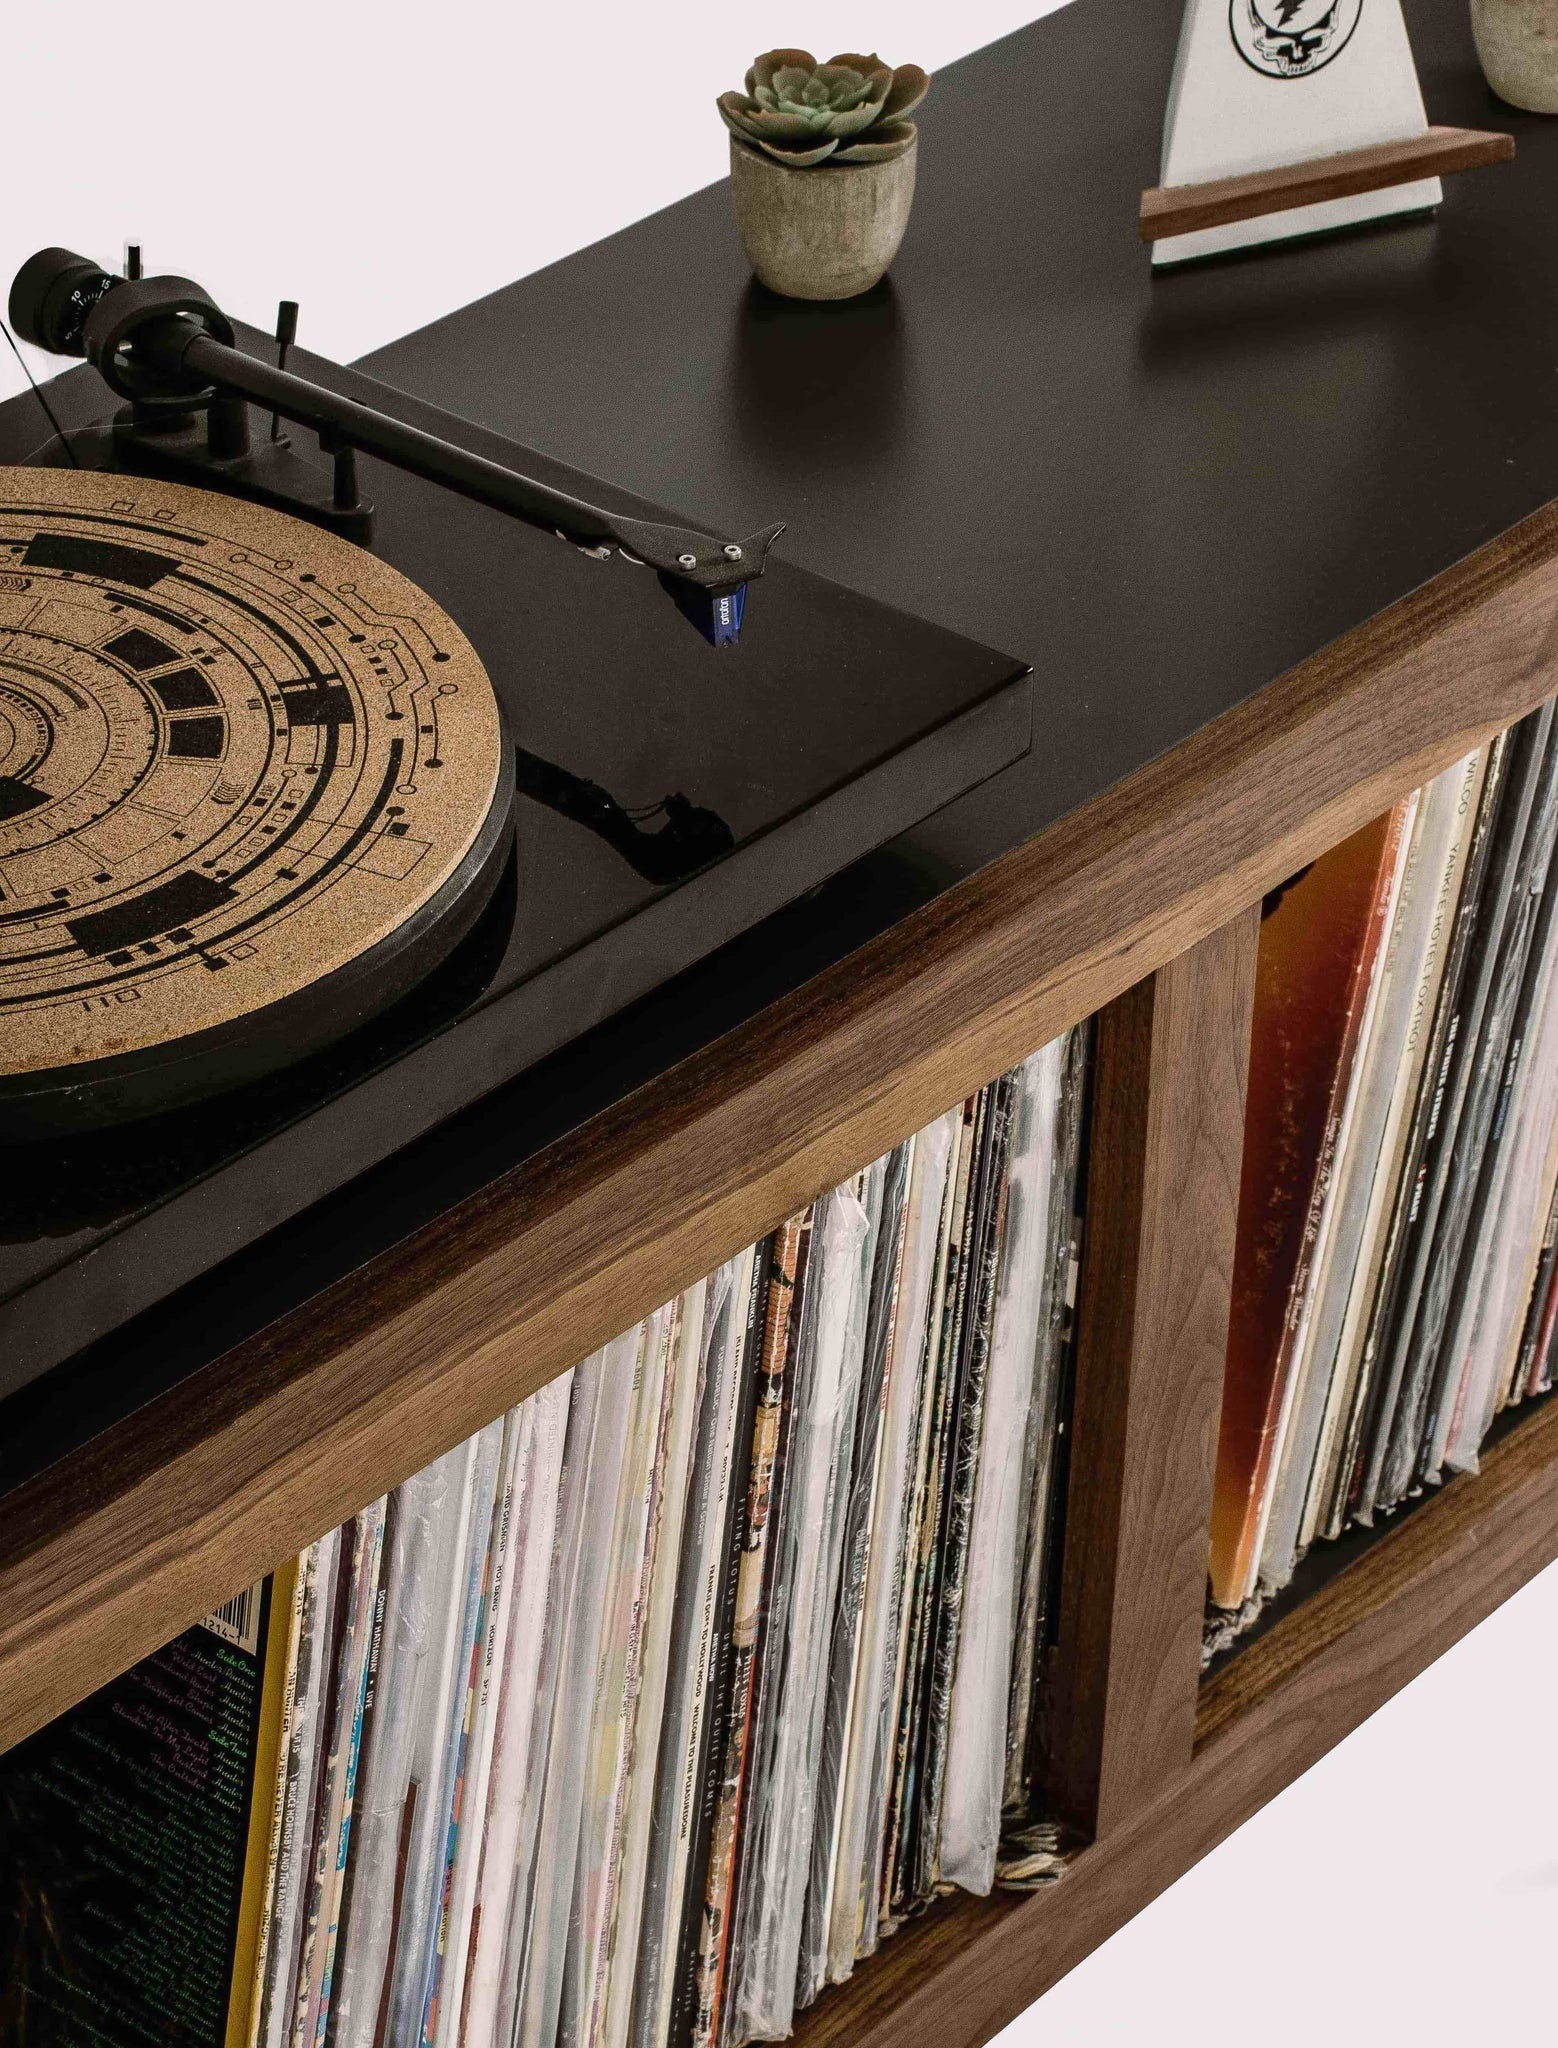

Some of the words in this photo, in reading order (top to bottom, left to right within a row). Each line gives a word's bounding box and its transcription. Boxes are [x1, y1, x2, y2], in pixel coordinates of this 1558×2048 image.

[71, 290, 81, 302] 10
[101, 278, 112, 290] 15
[1458, 756, 1477, 815] WILCO
[1437, 842, 1458, 911] YANKEE
[1424, 914, 1443, 971] HOTEL
[1448, 1014, 1459, 1042] THE
[1438, 1041, 1453, 1087] WHITE
[1427, 1086, 1443, 1140] STRIPES
[752, 1254, 761, 1286] ARETHA
[746, 1288, 757, 1328] FRANKLIN
[711, 1346, 726, 1409] FUNKADELIC
[498, 1510, 508, 1552] GRISMAN
[697, 1510, 705, 1544] Groove
[733, 1497, 745, 1551] FLYING
[706, 1565, 714, 1602] FRANKIE
[727, 1560, 738, 1604] LOTUS
[374, 1589, 386, 1622] DONNY
[368, 1625, 382, 1672] HATHAWAY
[702, 1628, 707, 1639] TO
[709, 1633, 718, 1663] ARETHA
[216, 1648, 238, 1667] Side
[238, 1660, 256, 1678] One
[695, 1642, 706, 1696] HOLLYWOOD
[707, 1664, 715, 1681] NOW
[719, 1632, 730, 1676] UNTIL
[365, 1690, 373, 1709] LIVE
[716, 1684, 724, 1709] THE
[690, 1704, 699, 1744] WELCOME
[709, 1717, 722, 1761] QUIET
[208, 1730, 230, 1747] Side
[229, 1743, 249, 1758] Two
[689, 1746, 694, 1757] TO
[286, 1780, 298, 1809] BRUCE
[680, 1775, 692, 1839] PLEASUREDOME
[703, 1769, 716, 1818] COMES
[282, 1809, 295, 1849] HORNSBY
[278, 1872, 287, 1887] THE
[280, 1852, 289, 1870] AND
[274, 1887, 285, 1918] RANGE
